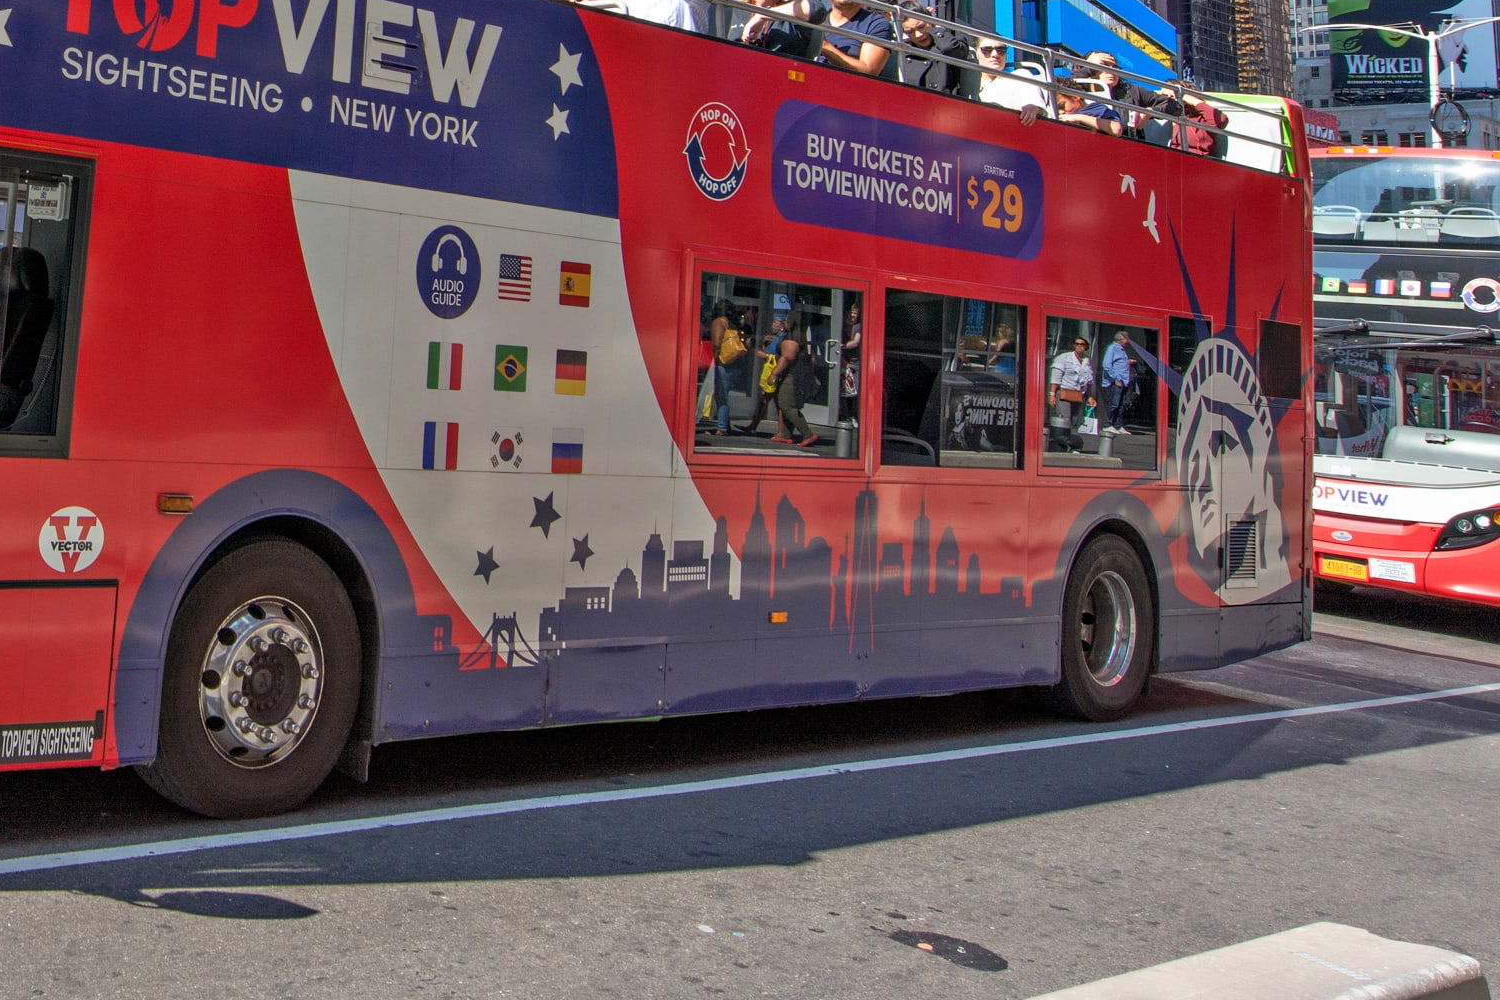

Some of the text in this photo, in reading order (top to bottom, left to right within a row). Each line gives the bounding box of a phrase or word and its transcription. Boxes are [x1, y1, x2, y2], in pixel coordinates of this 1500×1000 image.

[61, 47, 479, 149] SIGHTSEEING NEW YORK
[700, 109, 736, 131] HOP ON
[806, 133, 953, 185] BUY TICKETS AT
[983, 164, 1015, 179] STARTING AT
[698, 173, 737, 195] HOP OFF
[783, 159, 953, 216] TOPVIEWNYC.COM
[967, 175, 1024, 233] $29
[432, 279, 465, 294] AUDIO
[431, 292, 462, 307] GUIDE
[1313, 485, 1388, 507] OPVIEW
[50, 540, 93, 552] VECTOR
[1, 728, 41, 757] TOPVIEW
[40, 726, 95, 756] SIGHTSEEING
